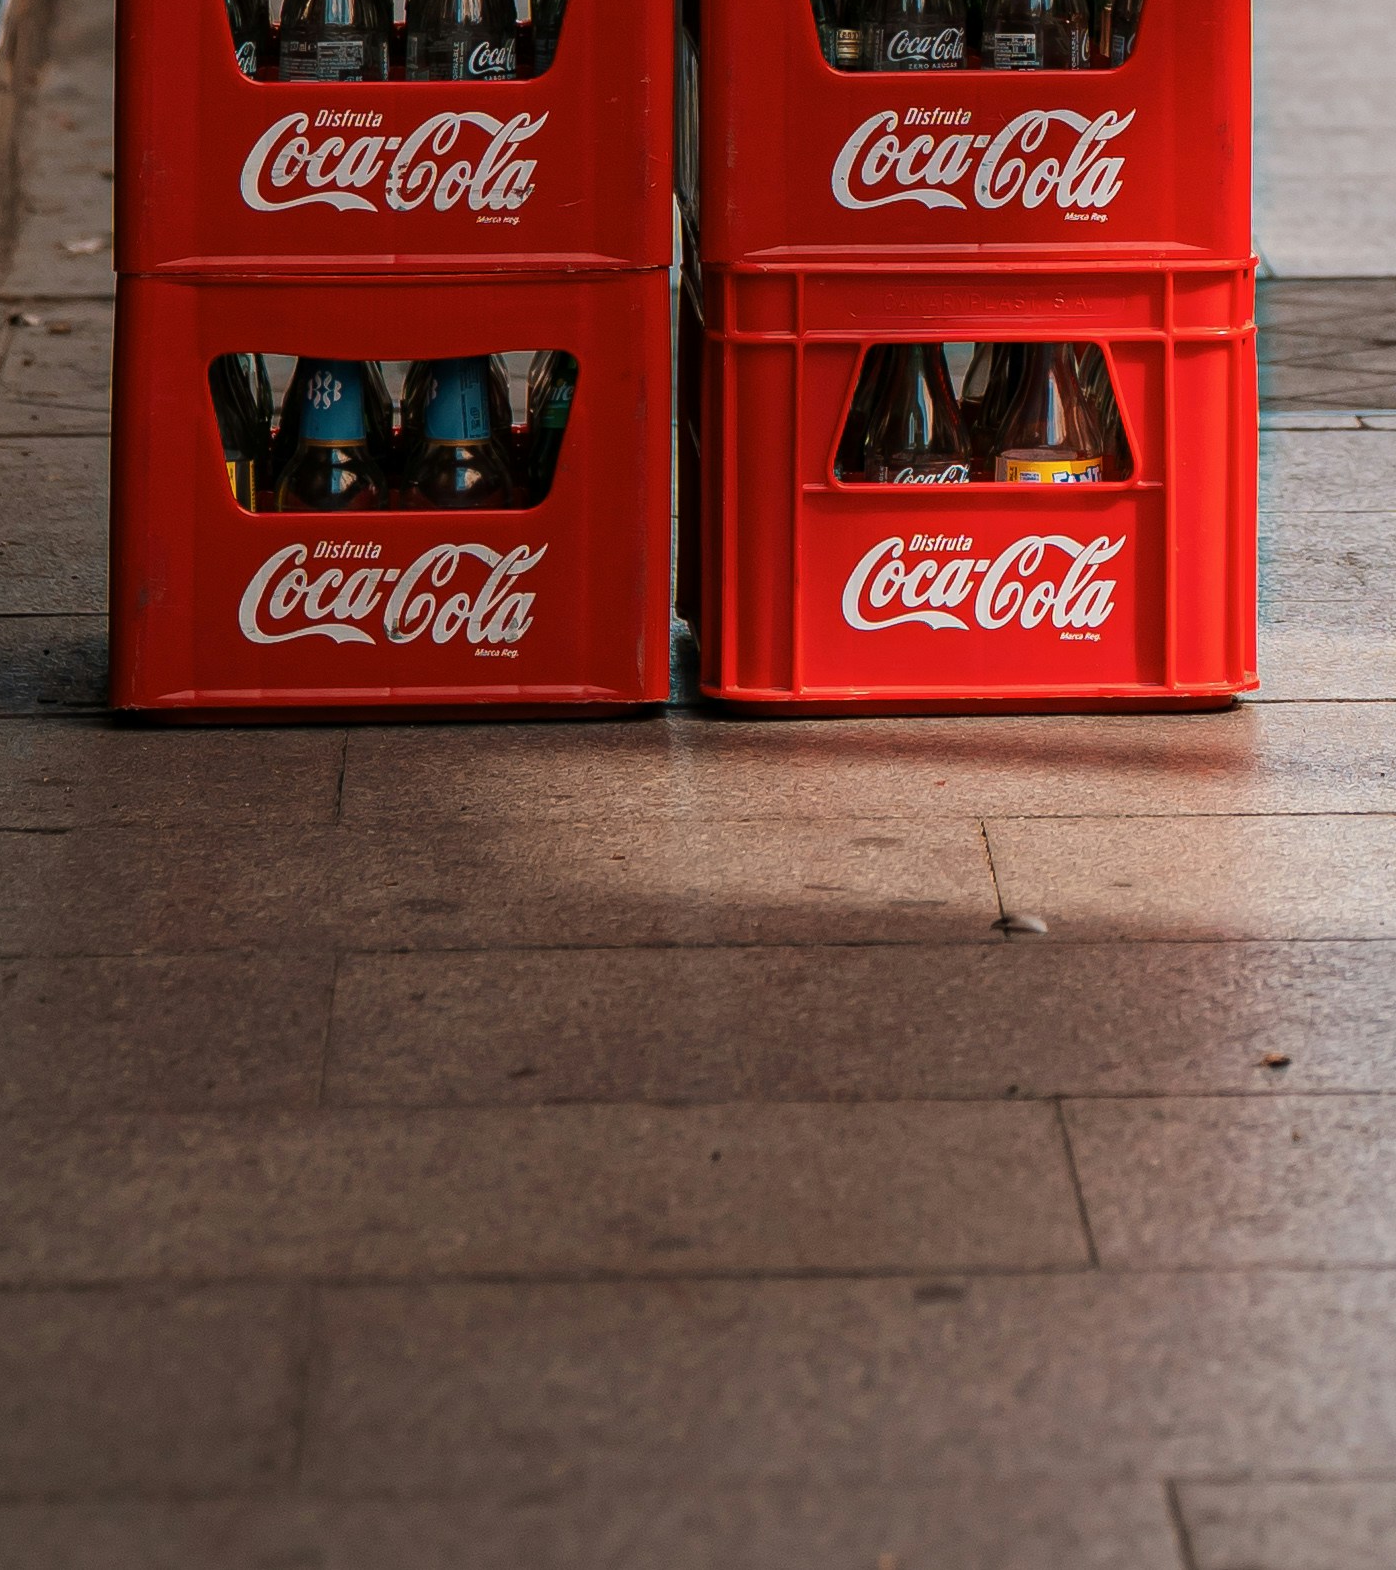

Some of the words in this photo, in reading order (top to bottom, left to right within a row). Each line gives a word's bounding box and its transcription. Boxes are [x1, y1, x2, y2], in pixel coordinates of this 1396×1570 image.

[314, 108, 383, 128] Disfruta
[904, 106, 972, 126] Disfruta
[240, 110, 549, 212] Coca-Cola
[831, 108, 1136, 210] Coca-Cola
[1064, 212, 1089, 221] Marca
[1090, 212, 1108, 223] Reg.
[313, 540, 382, 559] Disfruta
[908, 533, 973, 552] Disfruta
[842, 534, 1127, 631] Coca-Cola
[238, 542, 549, 645] Coca-Cola
[1060, 633, 1083, 641] Marca
[1084, 633, 1101, 642] Reg.
[475, 648, 500, 656] Marca
[501, 648, 519, 659] Reg.
